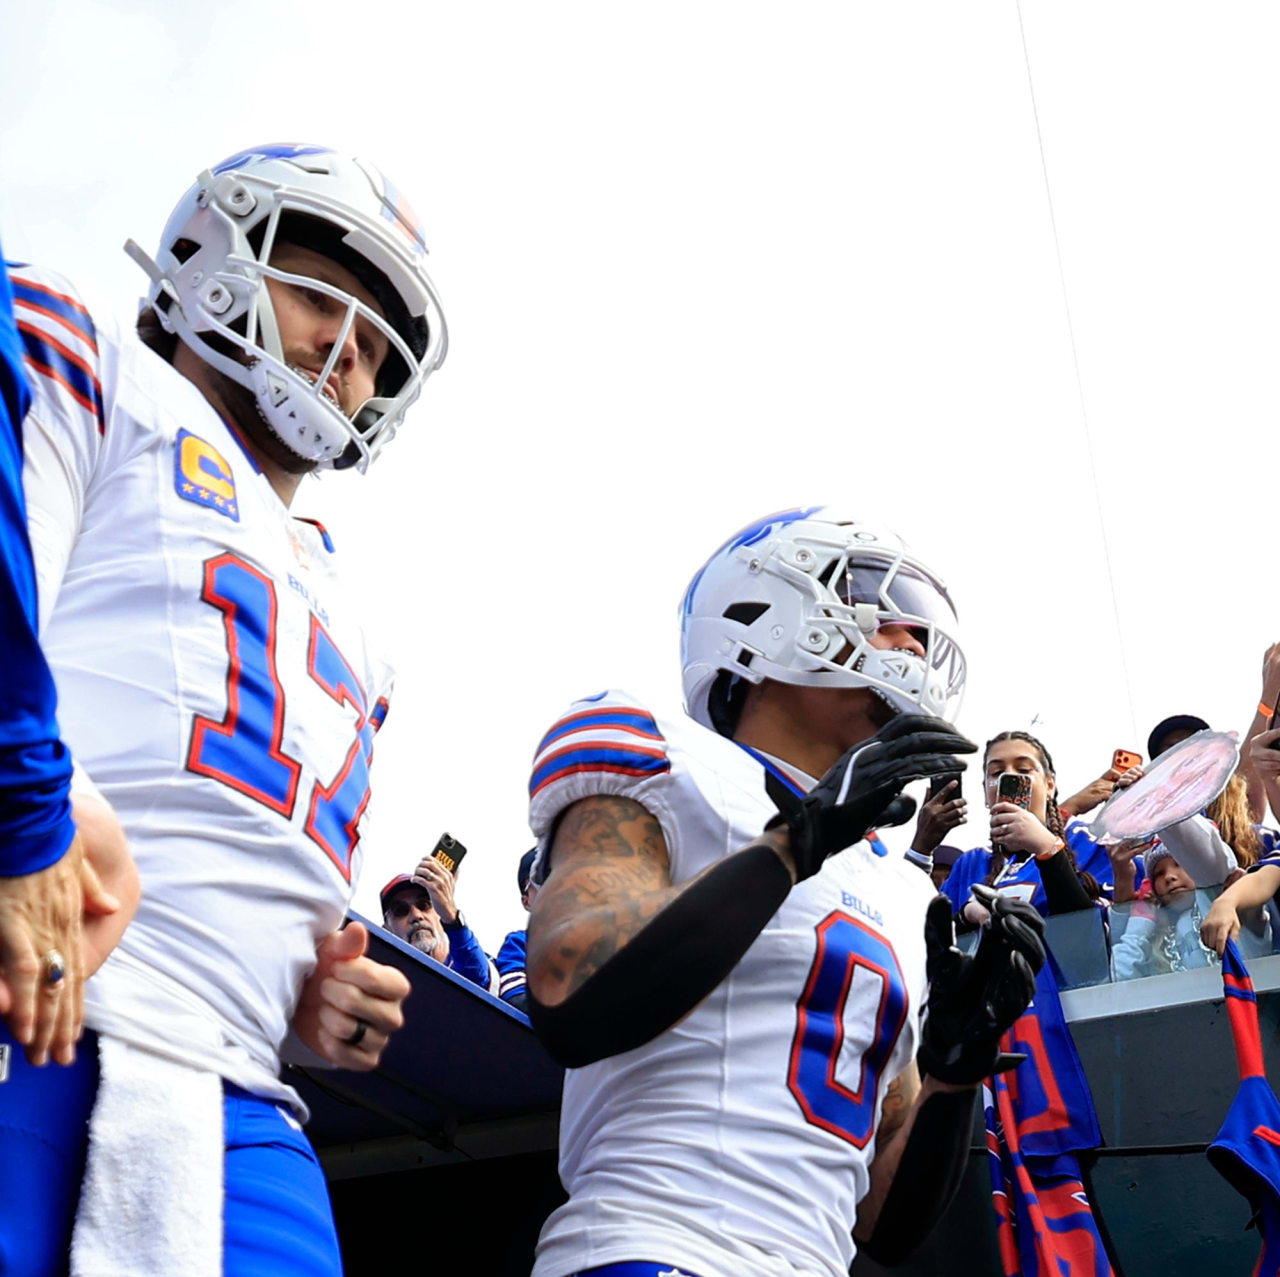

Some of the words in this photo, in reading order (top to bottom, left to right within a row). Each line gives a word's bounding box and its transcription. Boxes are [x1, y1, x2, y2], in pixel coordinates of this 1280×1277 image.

[180, 435, 235, 500] C
[186, 551, 372, 881] 17
[841, 890, 884, 927] BILLS
[787, 908, 909, 1150] 0
